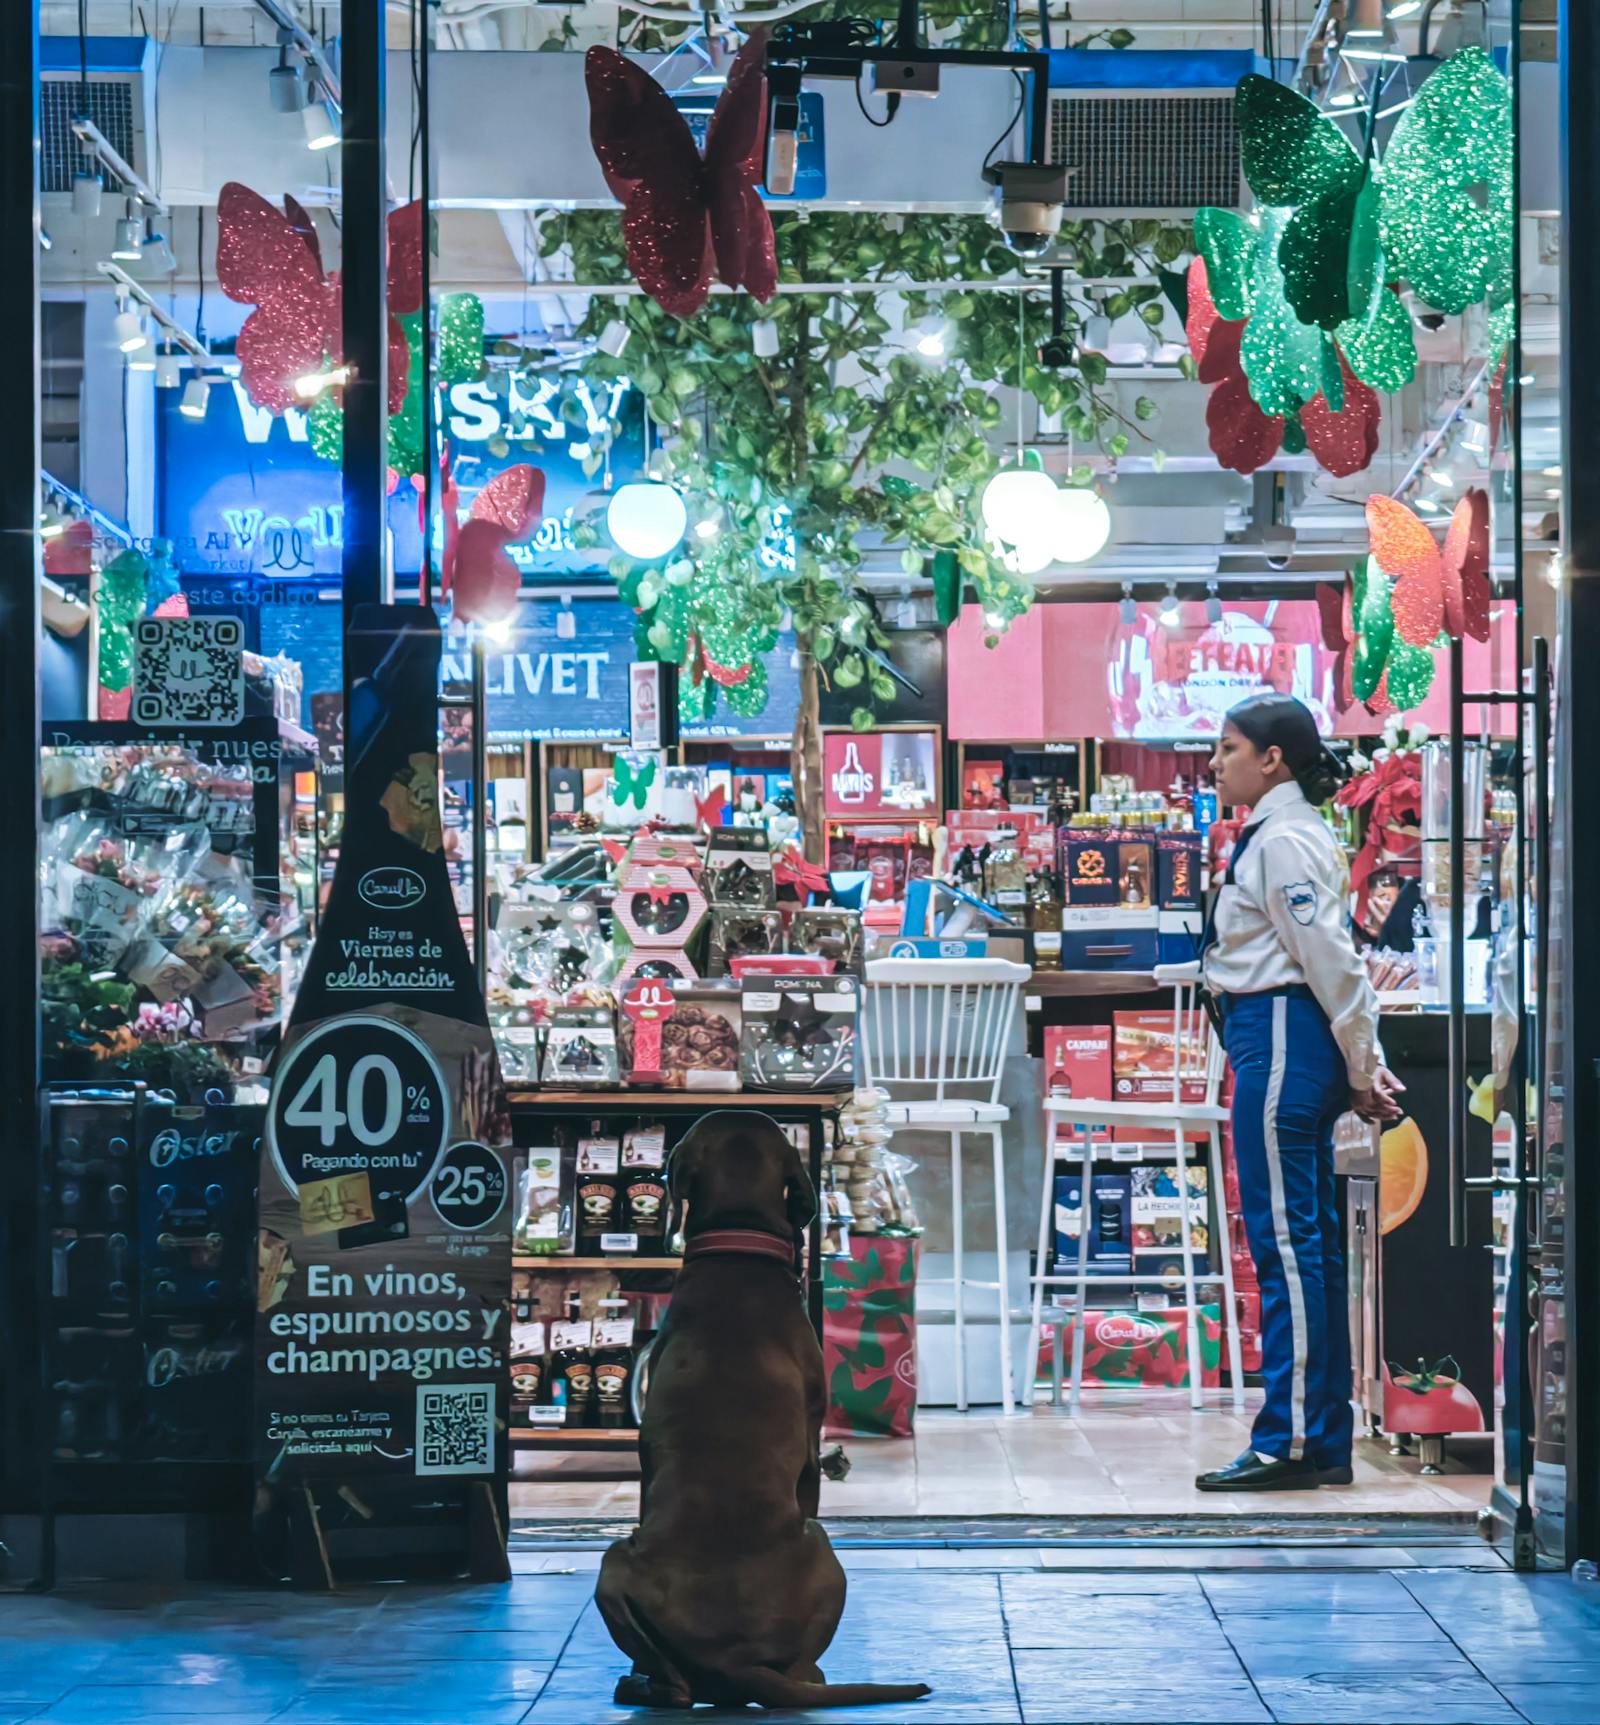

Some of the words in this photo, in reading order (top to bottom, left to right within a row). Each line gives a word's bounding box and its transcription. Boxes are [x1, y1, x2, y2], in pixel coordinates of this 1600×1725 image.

[340, 940, 414, 958] Viernes
[419, 939, 442, 958] de
[325, 960, 455, 987] celebración
[302, 1153, 368, 1172] Pagando
[371, 1155, 399, 1167] con
[308, 1265, 353, 1297] En
[364, 1264, 466, 1300] vinos,
[270, 1308, 471, 1345] espumosos
[481, 1308, 501, 1340] y
